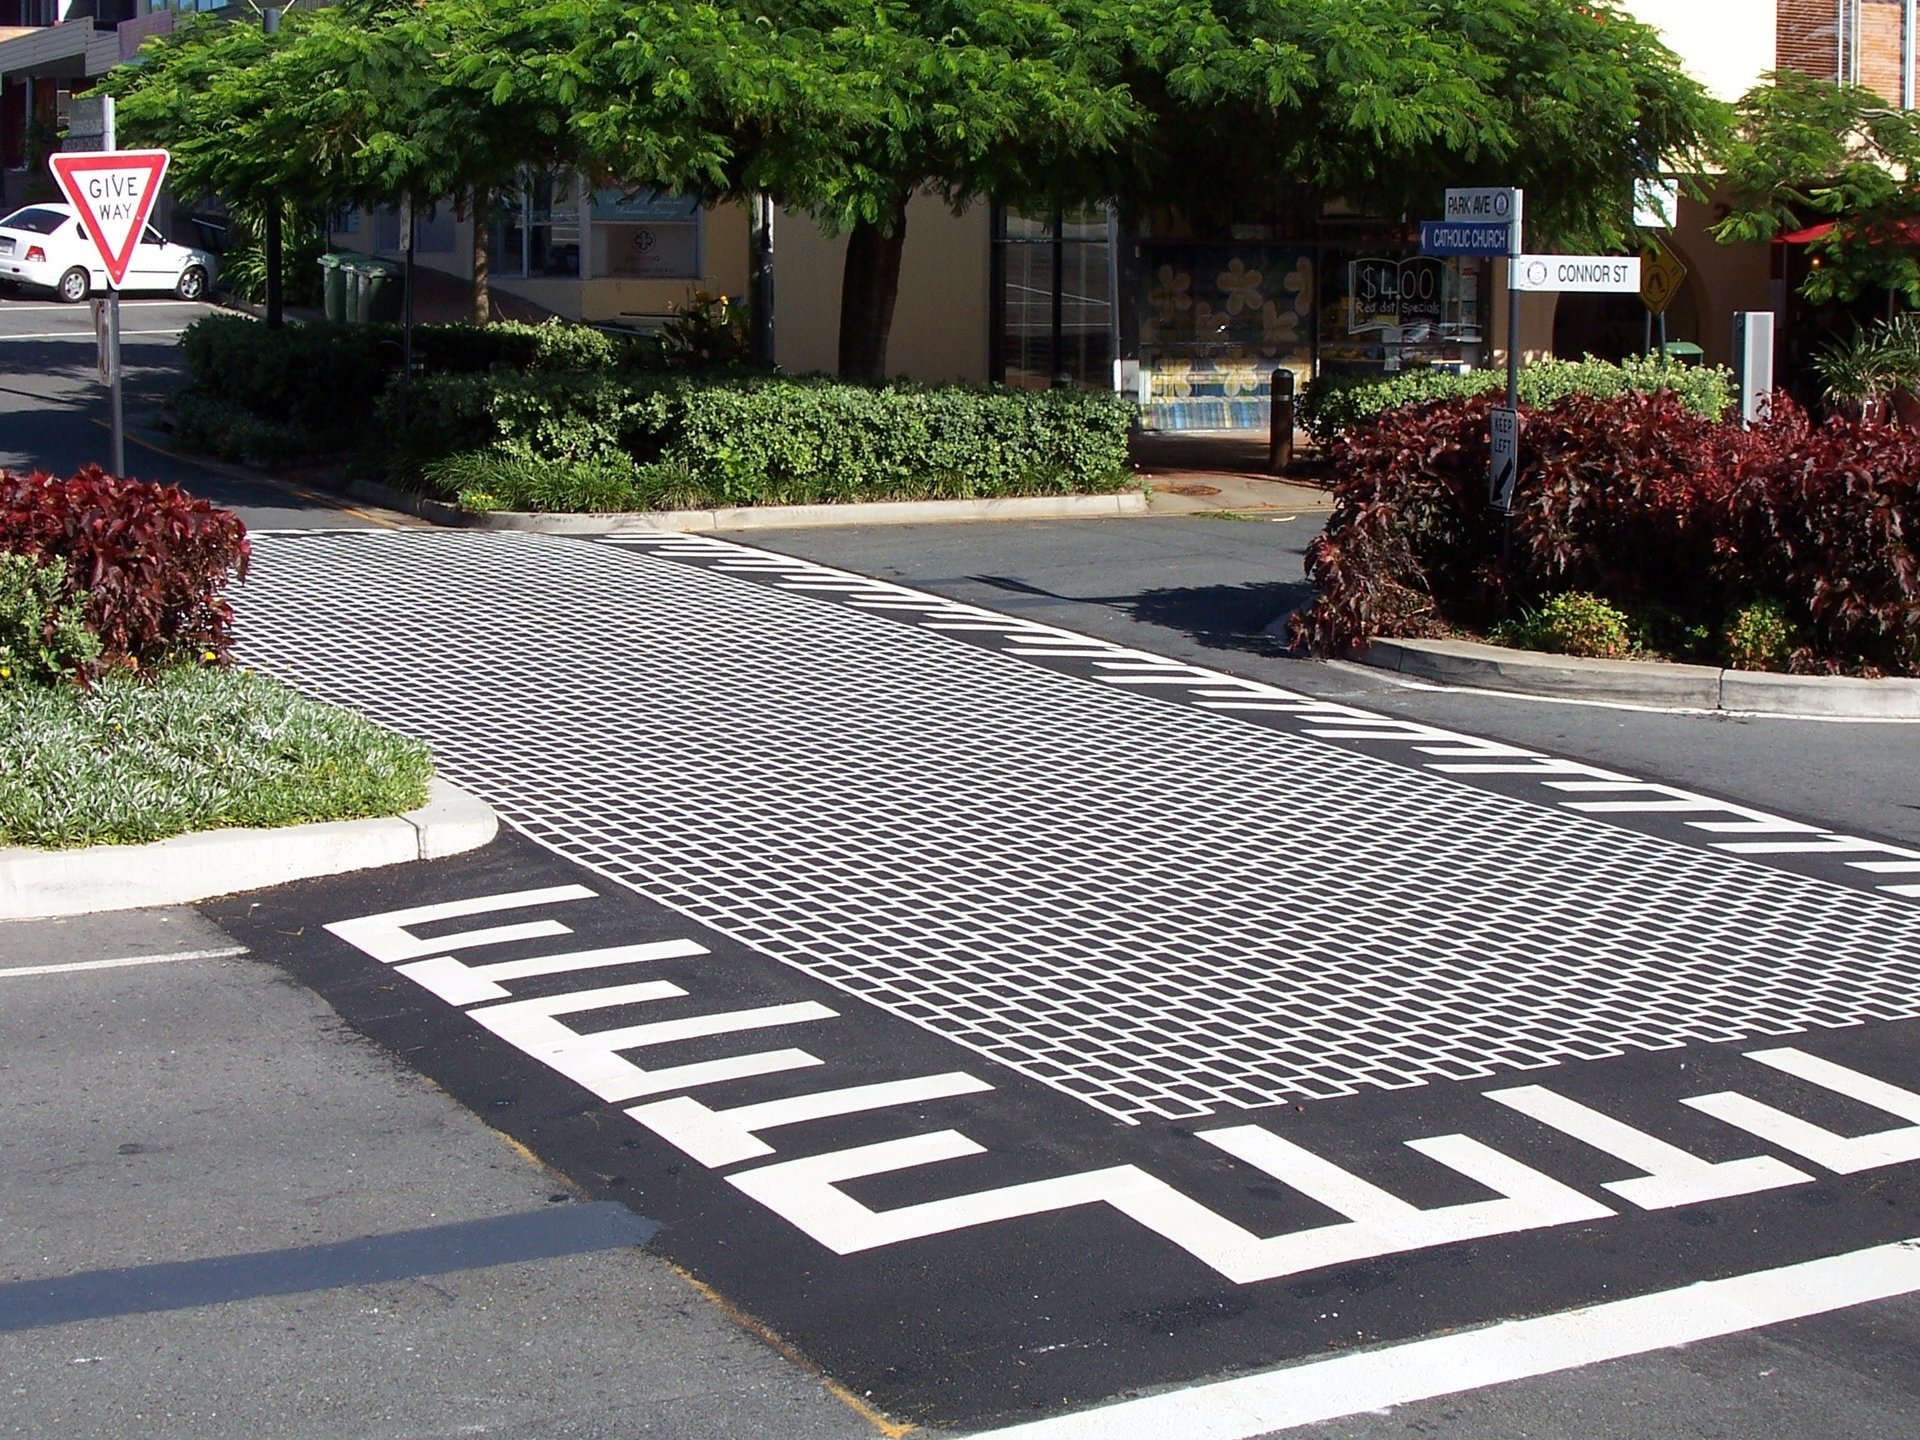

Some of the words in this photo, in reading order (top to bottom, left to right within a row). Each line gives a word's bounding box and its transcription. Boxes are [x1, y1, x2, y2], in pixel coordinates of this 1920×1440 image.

[89, 176, 138, 199] GIVE
[99, 203, 132, 220] WAY
[1447, 196, 1471, 215] PARK
[1473, 195, 1491, 214] AVE
[1433, 228, 1472, 248] CATHOLIC
[1472, 228, 1506, 248] CHURCH
[1361, 264, 1434, 301] $4.00
[1557, 264, 1610, 283] CONNOR
[1613, 264, 1628, 283] ST
[1355, 301, 1376, 314] Red
[1379, 301, 1396, 313] dot
[1401, 301, 1440, 316] Specials
[1494, 417, 1513, 434] KEEP
[1494, 438, 1511, 456] LEFT
